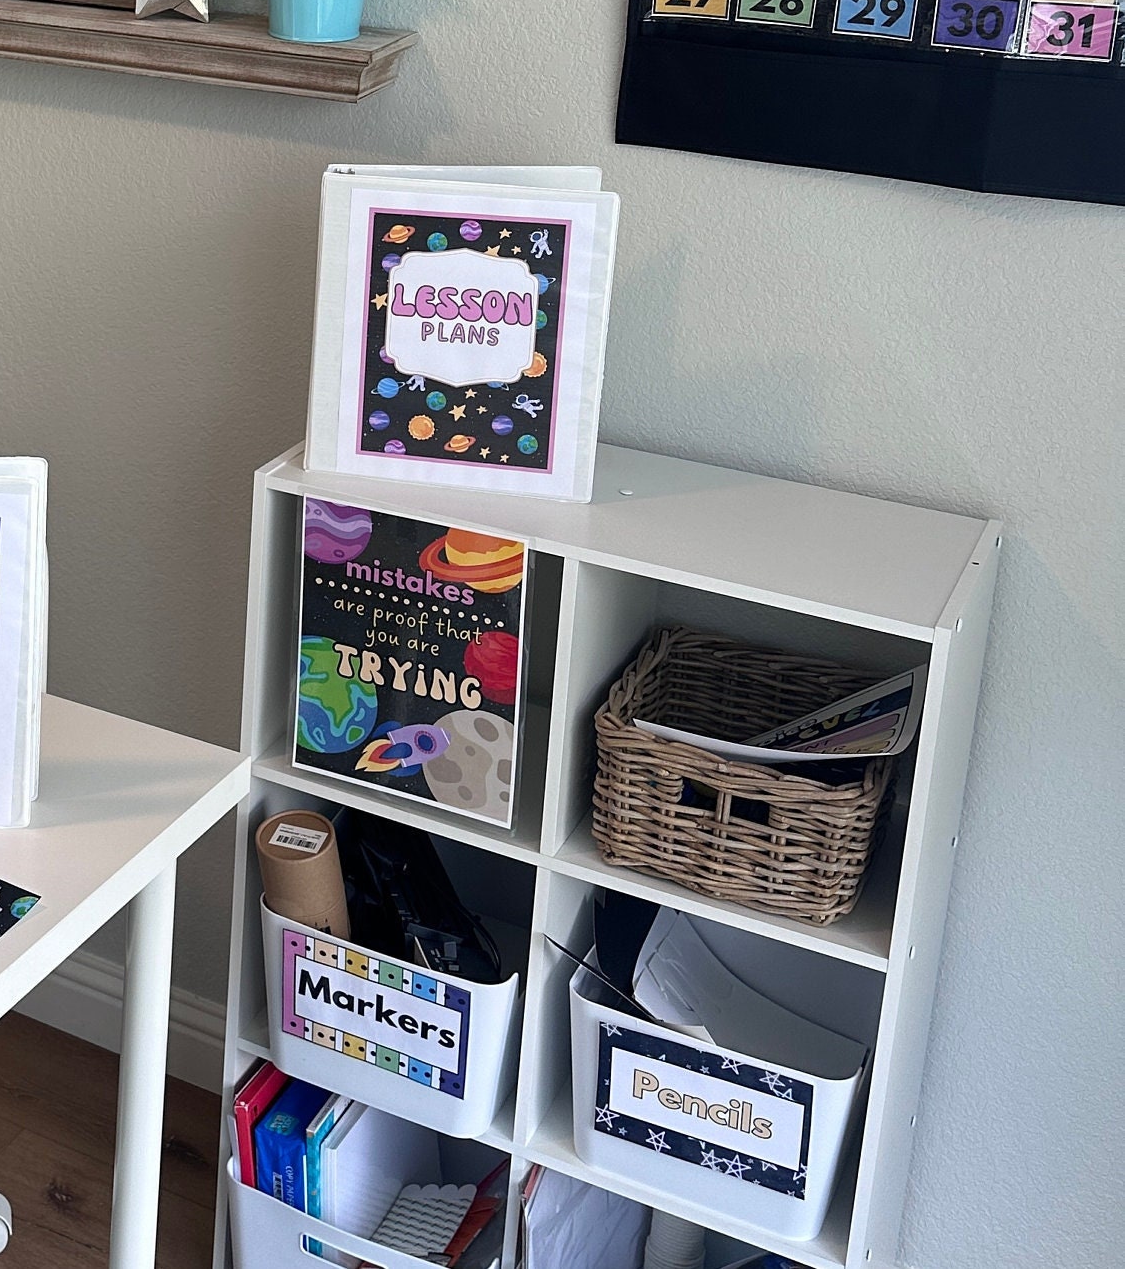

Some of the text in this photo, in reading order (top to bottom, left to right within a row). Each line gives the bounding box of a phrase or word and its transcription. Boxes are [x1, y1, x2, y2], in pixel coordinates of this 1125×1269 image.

[946, 3, 1005, 41] 30
[1046, 10, 1096, 49] 31
[391, 282, 533, 326] LESSON
[421, 322, 500, 347] PLANS
[346, 559, 476, 606] mistakes
[334, 598, 483, 645] are proof that
[365, 629, 440, 656] you are
[298, 969, 456, 1049] Markers
[631, 1067, 774, 1141] Pencils
